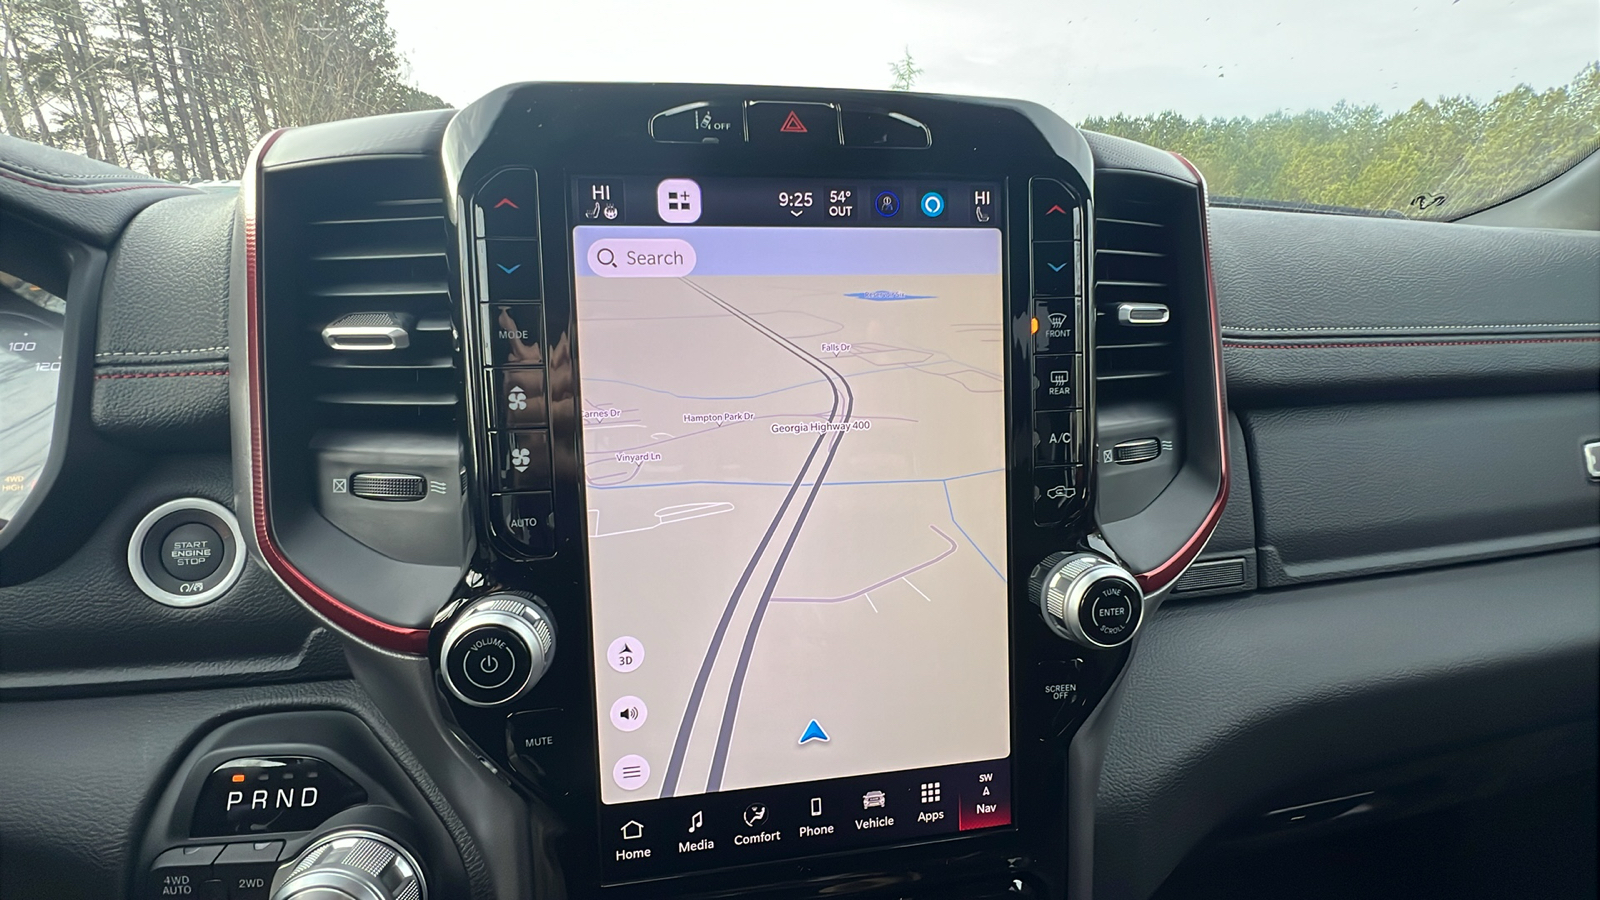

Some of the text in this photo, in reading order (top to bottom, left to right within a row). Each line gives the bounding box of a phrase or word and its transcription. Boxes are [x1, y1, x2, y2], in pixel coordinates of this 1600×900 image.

[713, 122, 731, 131] OFF
[592, 184, 610, 200] HI
[778, 191, 813, 208] 9:25
[974, 190, 990, 205] HI
[829, 206, 852, 218] OUT
[626, 250, 684, 266] Search
[498, 330, 528, 340] MODE
[1045, 329, 1071, 338] FRONT
[9, 342, 36, 352] 100
[821, 343, 850, 352] Falls Dr
[35, 362, 61, 372] 120
[1049, 387, 1070, 395] REAR
[610, 409, 621, 417] Dr
[683, 412, 754, 424] Hampton Park Dr
[771, 420, 871, 434] Georgia Highway 400
[1049, 432, 1071, 444] A/C
[616, 451, 661, 463] Vinyard Ln
[511, 517, 537, 528] AUTO
[174, 541, 208, 550] START
[171, 549, 211, 558] ENGINE
[177, 557, 205, 566] STOP
[1102, 588, 1122, 597] TUNE
[1099, 607, 1125, 617] ENTER
[1100, 624, 1125, 634] SCROLL
[470, 637, 507, 651] VOLUME
[619, 656, 633, 665] 3D
[1045, 684, 1076, 694] SCREEN
[1053, 692, 1069, 700] OFF
[525, 736, 553, 747] MUTE
[979, 773, 993, 782] SW
[976, 803, 997, 814] Nav
[917, 810, 944, 823] Apps
[855, 816, 895, 830] Vehicle
[799, 824, 835, 837] Phone
[734, 830, 782, 845] Comfort
[678, 839, 715, 853] Media
[615, 848, 651, 861] Home
[164, 875, 190, 885] 4WD
[238, 878, 264, 888] 2WD
[162, 885, 192, 895] AUTO
